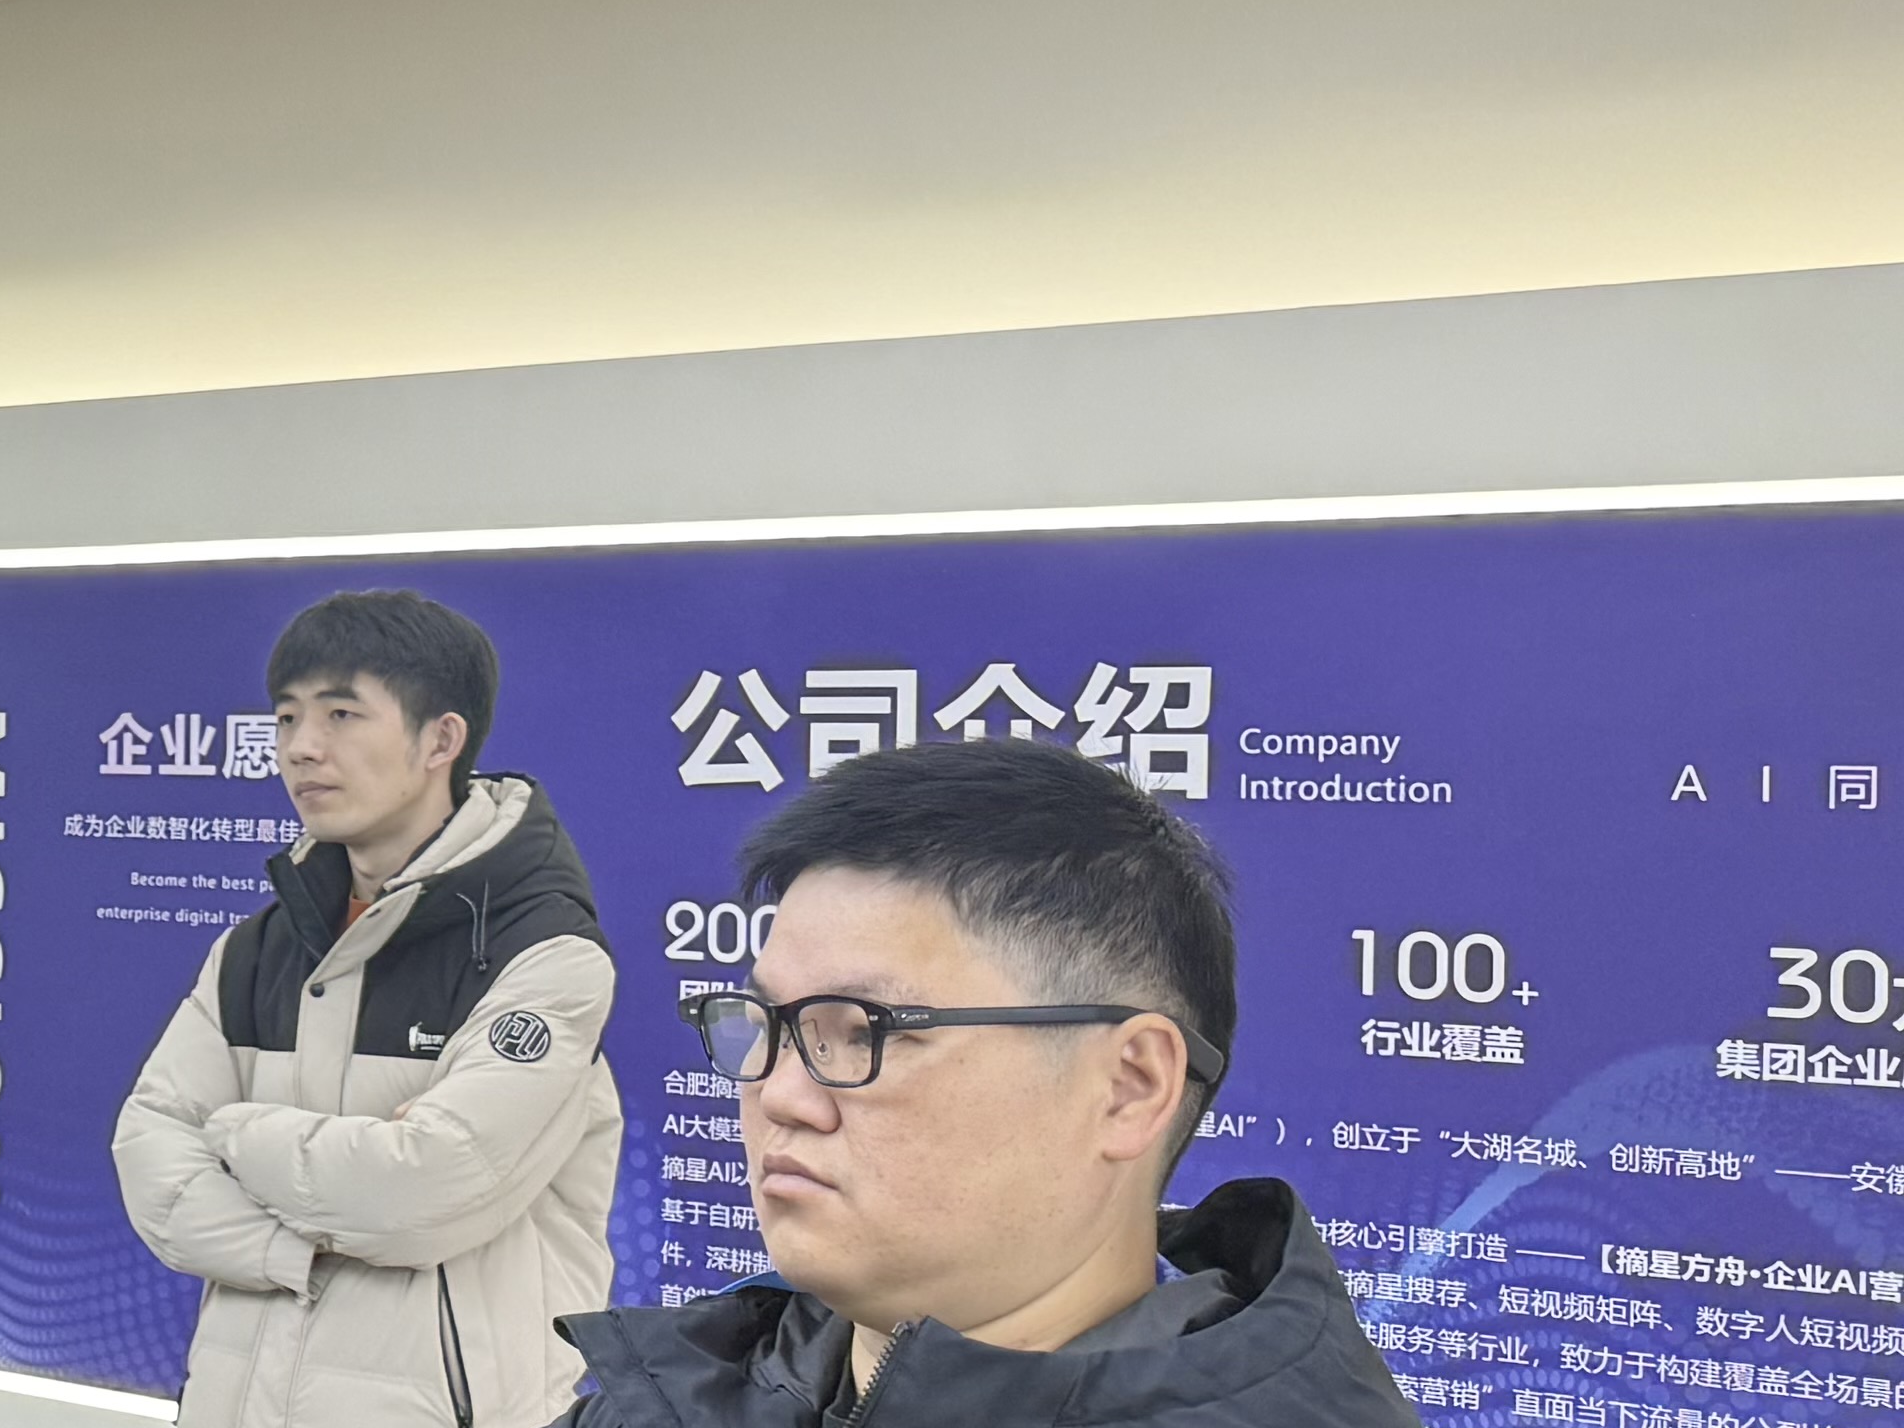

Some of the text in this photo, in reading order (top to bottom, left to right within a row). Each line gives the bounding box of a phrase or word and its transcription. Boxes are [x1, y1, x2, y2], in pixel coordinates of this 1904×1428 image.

[98, 712, 281, 780] 企业愿
[671, 662, 1213, 800] 公司介绍
[1239, 727, 1401, 764] Company
[1240, 773, 1453, 804] Introduction
[130, 871, 187, 888] Become
[192, 874, 218, 889] the
[220, 876, 256, 890] best
[96, 905, 171, 923] enterprise
[174, 908, 224, 927] digital
[1351, 929, 1539, 1004] 100+
[1767, 946, 1904, 1032] 30
[1361, 1019, 1525, 1065] 行业覆盖
[1716, 1039, 1904, 1089] 集团企业
[661, 1197, 759, 1231] 基于自研
